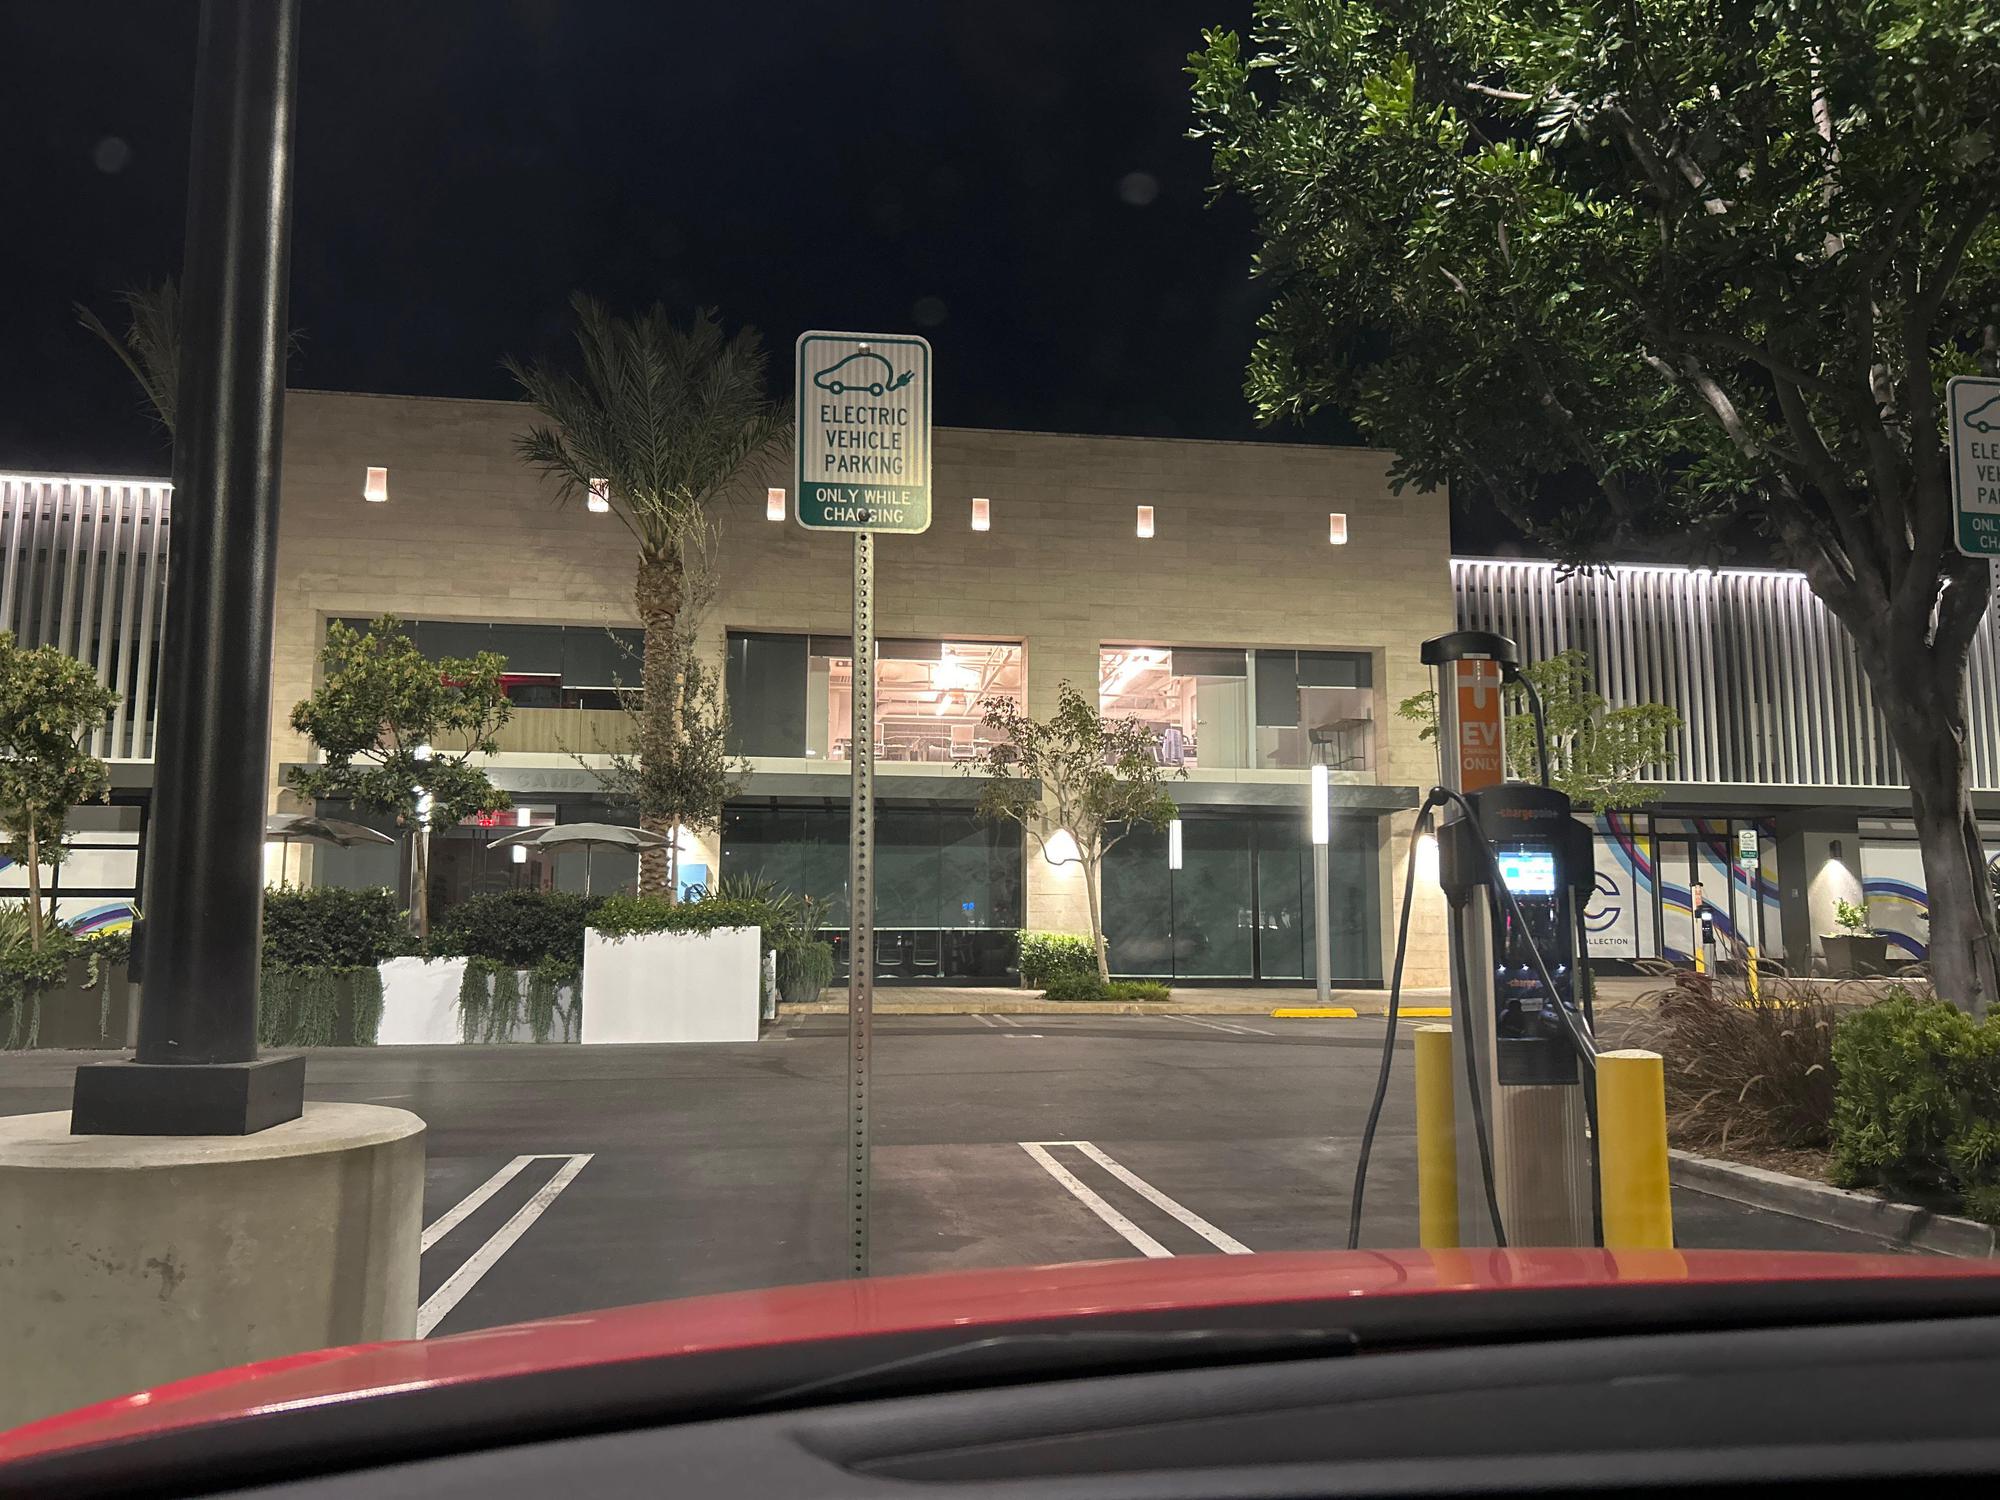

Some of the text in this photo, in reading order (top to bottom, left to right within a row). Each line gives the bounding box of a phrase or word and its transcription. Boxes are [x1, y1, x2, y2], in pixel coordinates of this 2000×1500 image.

[821, 405, 908, 425] ELECTRIC
[826, 429, 902, 450] VEHICLE
[825, 454, 903, 474] PARKING
[816, 488, 911, 505] ONLY WHILE
[1972, 518, 2000, 532] ONL
[1462, 721, 1498, 746] EV
[1463, 757, 1499, 770] ONLY
[518, 772, 585, 788] CAMP
